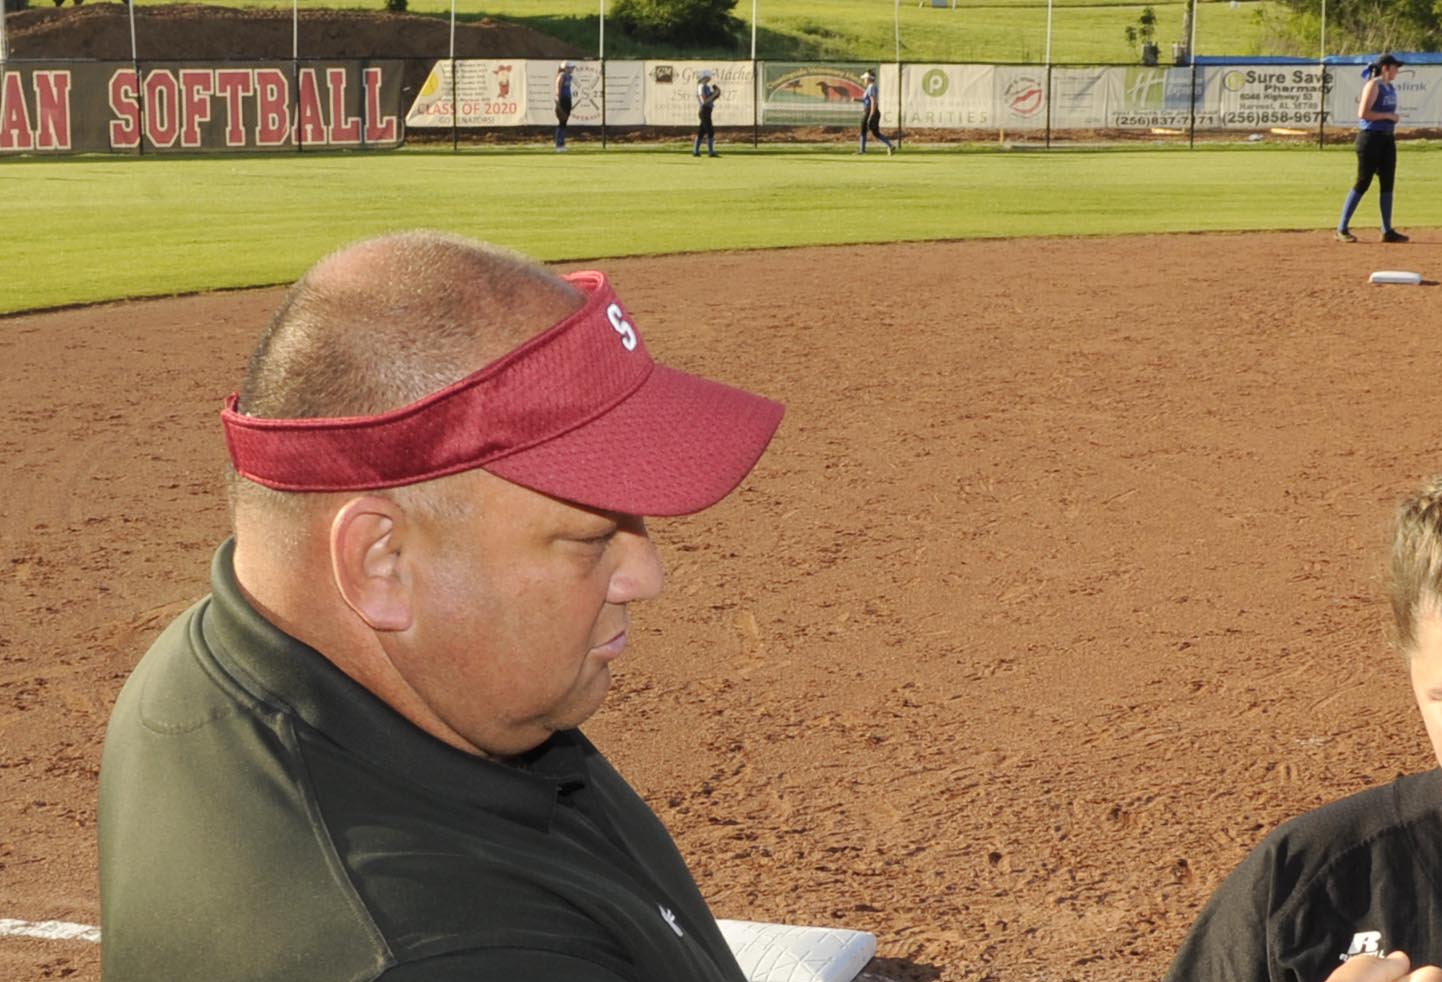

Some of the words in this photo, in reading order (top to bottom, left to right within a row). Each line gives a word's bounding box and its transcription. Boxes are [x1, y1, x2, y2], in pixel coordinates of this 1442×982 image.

[1245, 70, 1287, 84] Sure
[1292, 70, 1333, 84] Save
[1263, 93, 1300, 102] Highway
[109, 68, 397, 148] SOFTBALL
[417, 101, 455, 116] CLASS
[462, 102, 481, 116] OF
[484, 102, 517, 115] 2020
[1115, 116, 1213, 126] (256)837-771
[1222, 110, 1330, 126] (256)858-9677
[607, 303, 637, 352] S
[1347, 930, 1381, 955] R
